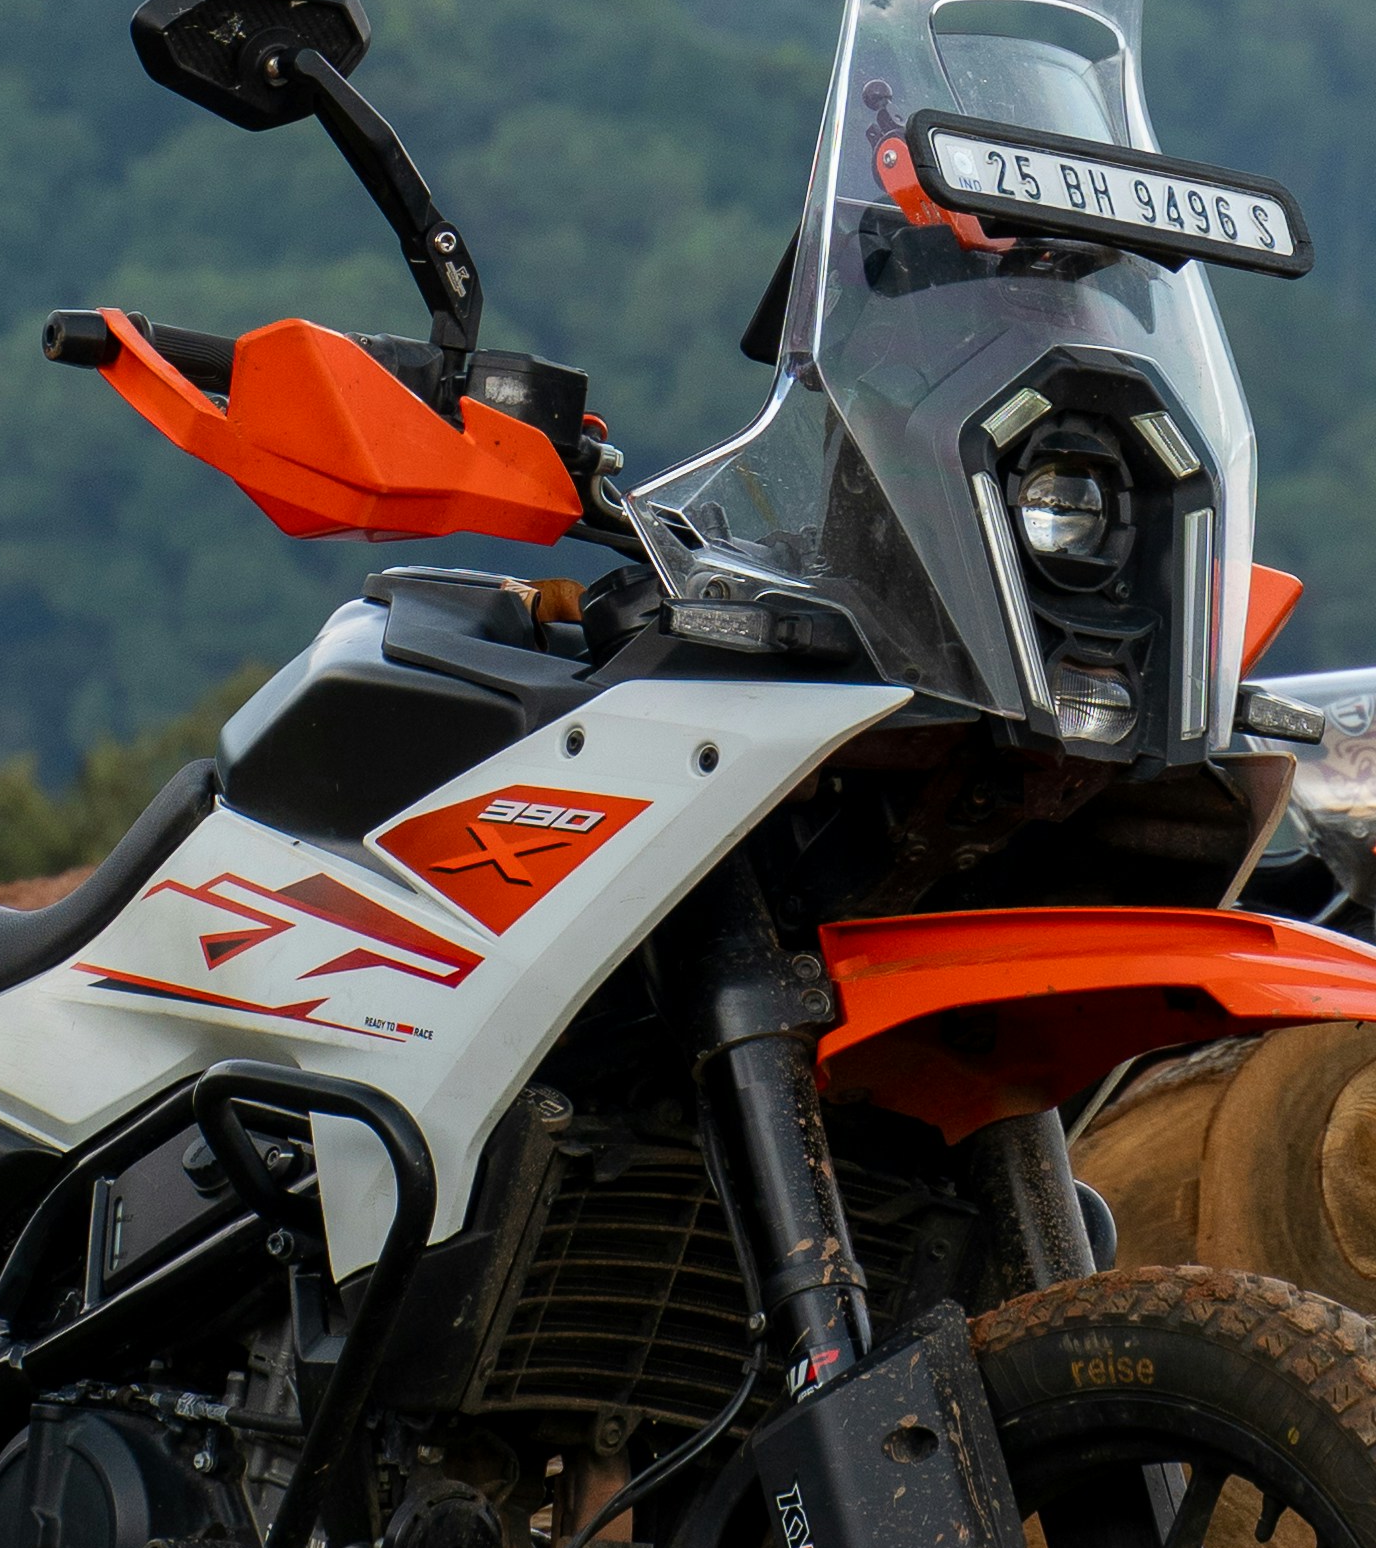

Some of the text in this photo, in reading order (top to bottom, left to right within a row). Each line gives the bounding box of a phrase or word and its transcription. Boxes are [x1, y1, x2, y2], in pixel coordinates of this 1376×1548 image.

[958, 175, 982, 192] IND
[987, 150, 1276, 250] 25 BH 9496 S
[477, 799, 607, 834] 390
[364, 1015, 434, 1041] READY TO RACE
[1071, 1350, 1155, 1388] reise
